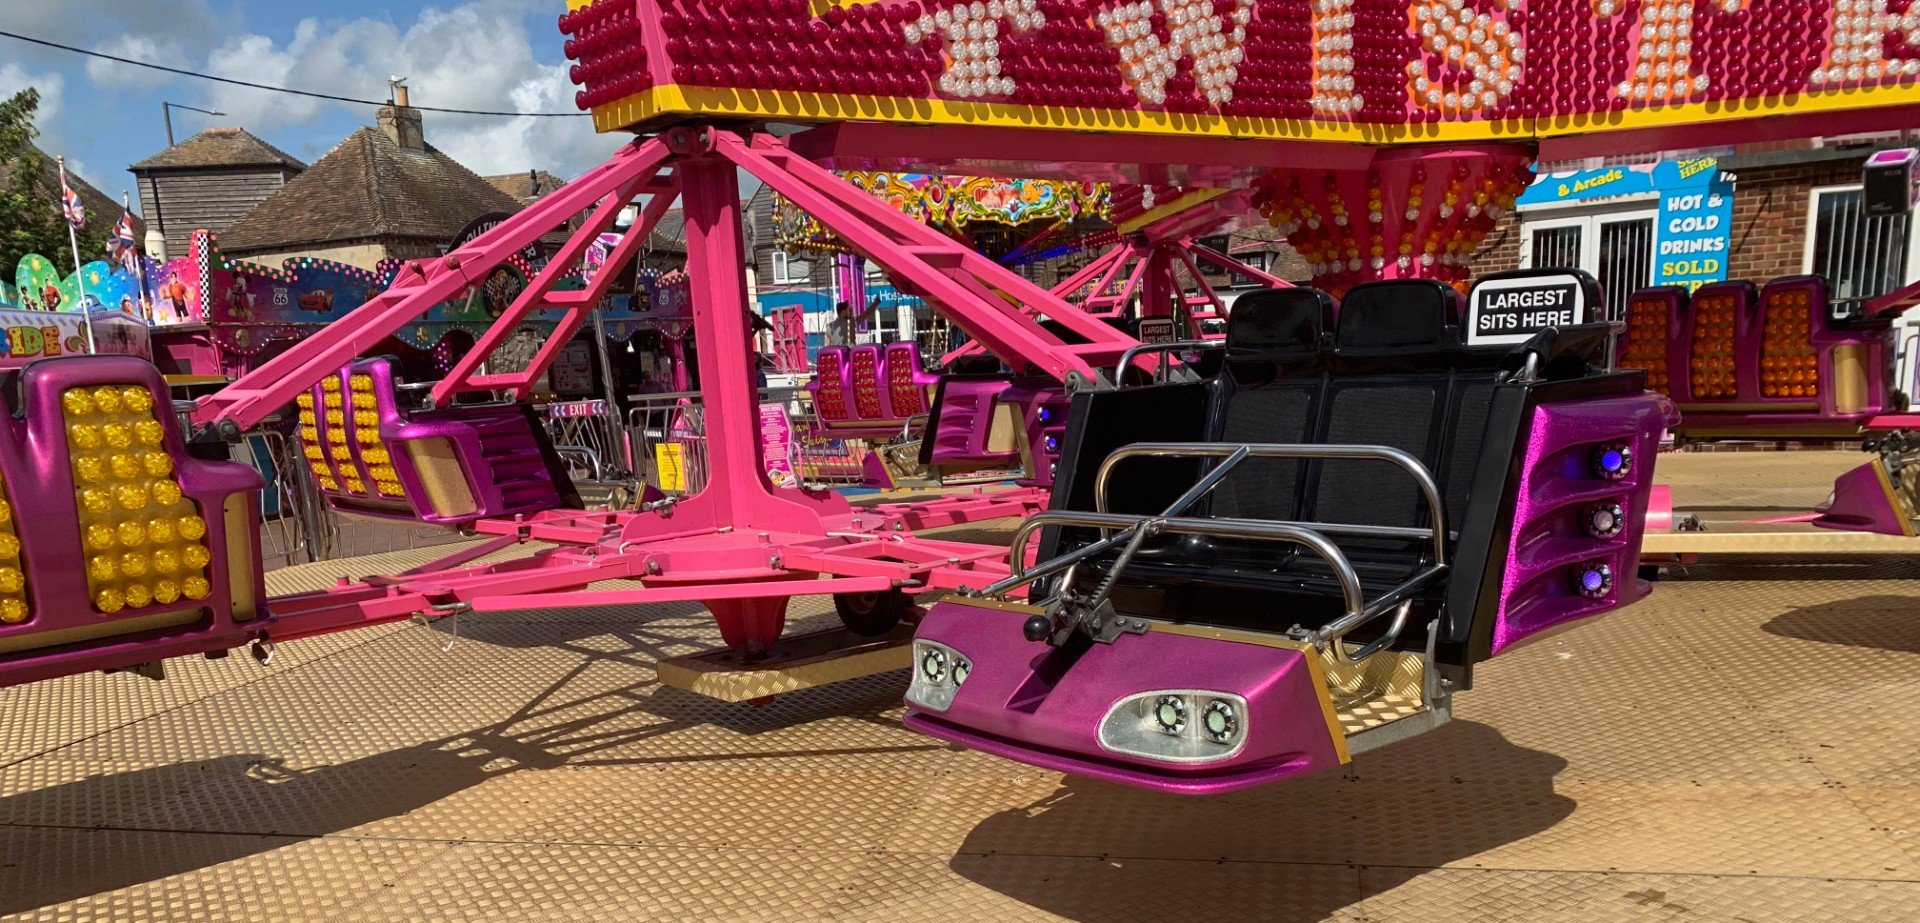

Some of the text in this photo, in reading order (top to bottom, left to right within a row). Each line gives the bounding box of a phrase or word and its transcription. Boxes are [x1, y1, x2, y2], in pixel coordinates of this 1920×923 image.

[1558, 184, 1570, 197] &
[1573, 169, 1623, 191] Arcade
[1668, 194, 1703, 212] HOT
[1707, 193, 1723, 208] &
[1669, 215, 1719, 233] COLD
[1660, 236, 1725, 255] DRINKS
[1662, 259, 1719, 276] SOLD
[1486, 289, 1568, 309] LARGEST
[1480, 310, 1571, 330] SITS HERE
[1143, 325, 1171, 334] LARGEST
[1156, 335, 1173, 343] HERE
[569, 403, 587, 416] EXIT
